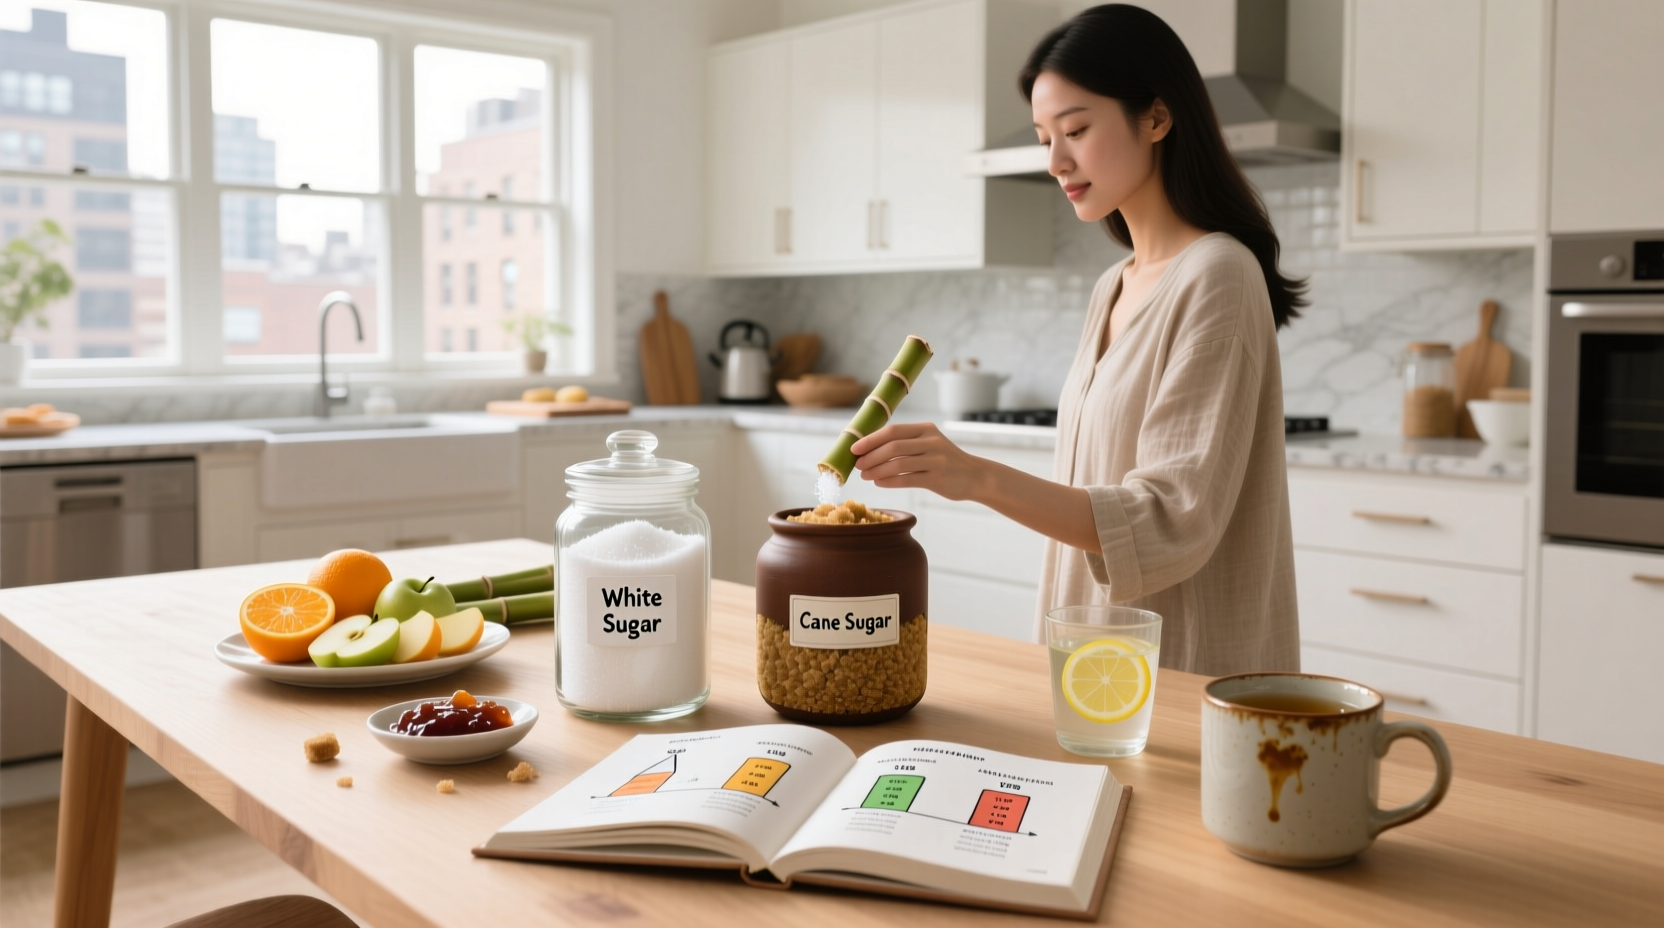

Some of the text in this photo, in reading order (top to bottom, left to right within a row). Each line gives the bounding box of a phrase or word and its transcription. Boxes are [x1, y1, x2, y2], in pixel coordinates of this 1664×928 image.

[602, 586, 662, 608] White
[603, 613, 662, 640] Sugar
[800, 611, 892, 636] Cane Sugar
